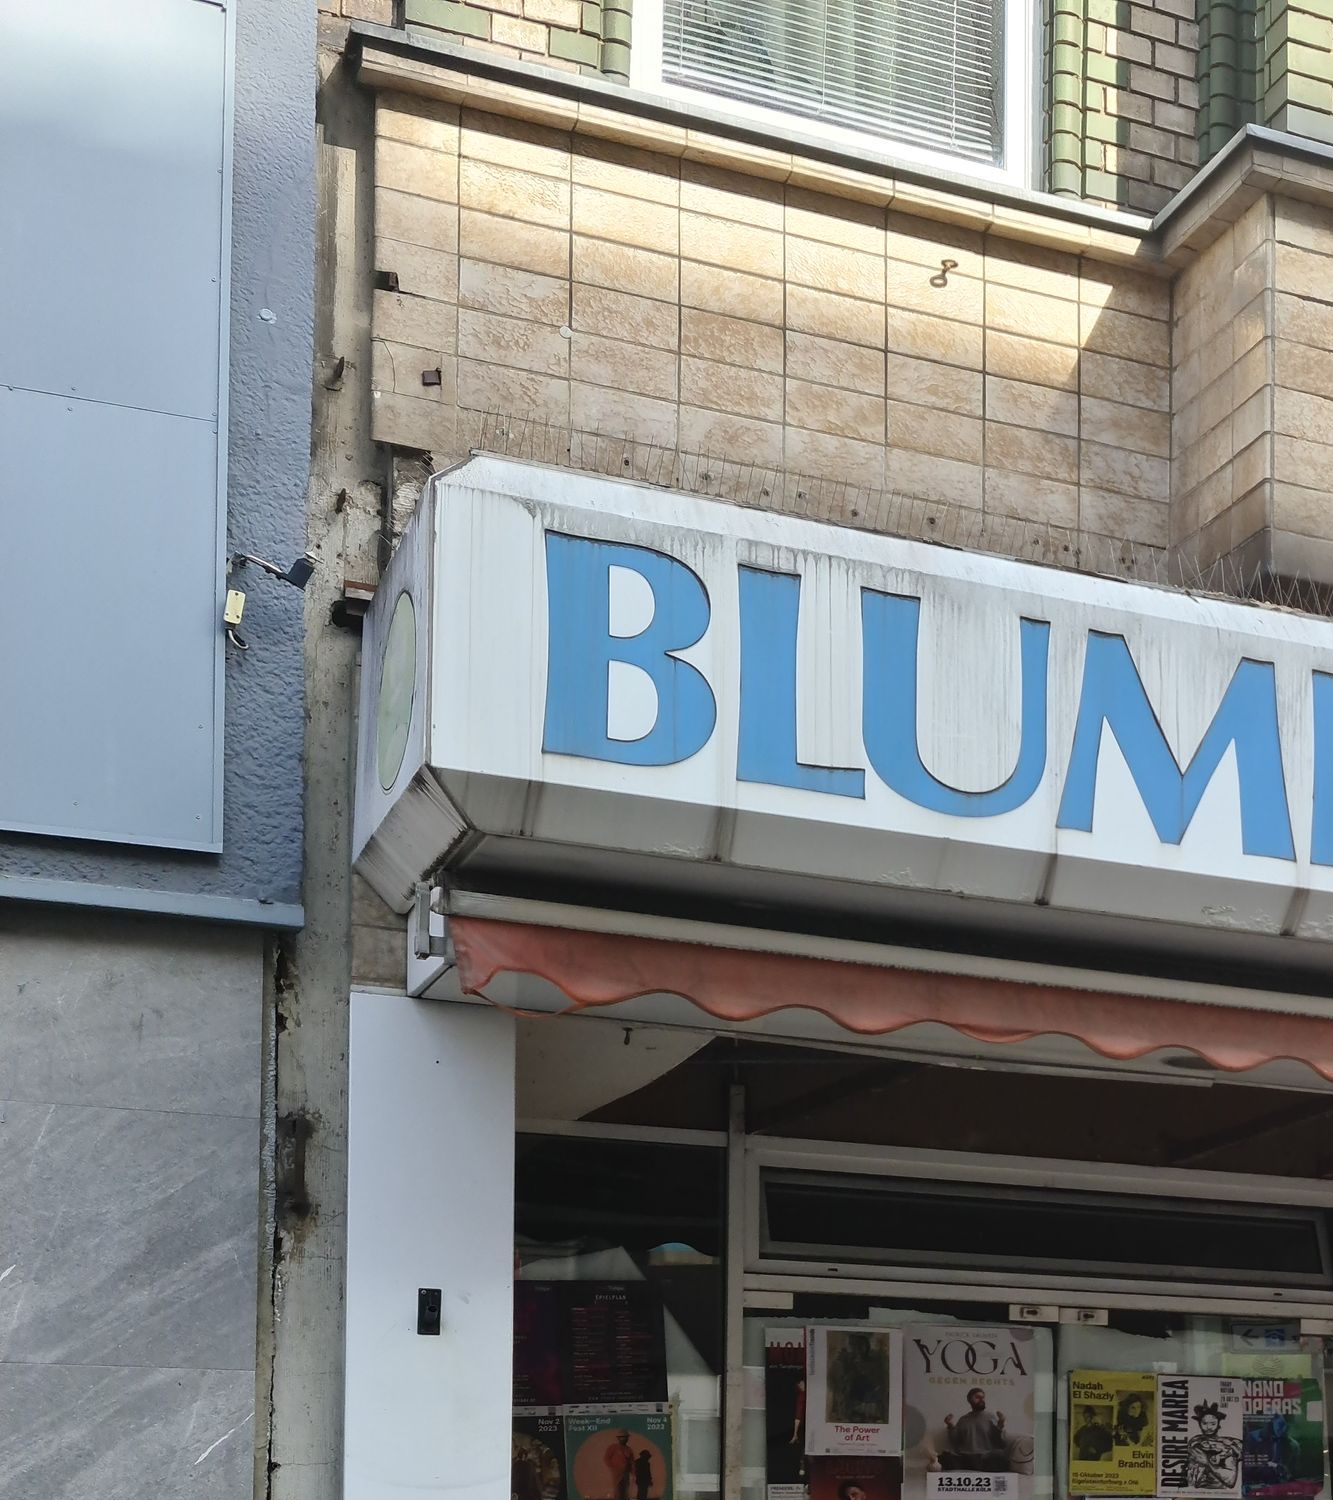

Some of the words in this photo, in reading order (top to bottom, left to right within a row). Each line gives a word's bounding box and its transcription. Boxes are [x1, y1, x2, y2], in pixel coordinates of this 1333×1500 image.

[913, 1339, 1028, 1375] YOGA
[1073, 1382, 1103, 1391] Nadah
[1084, 1392, 1115, 1402] Shazly
[1161, 1380, 1188, 1433] MAREA
[834, 1425, 850, 1436] The
[852, 1426, 881, 1436] Power
[856, 1434, 871, 1442] Art
[1132, 1450, 1154, 1459] Elvin
[1118, 1460, 1154, 1469] Brandhi
[1160, 1436, 1188, 1488] DESIRE
[938, 1477, 991, 1487] 13.10.23
